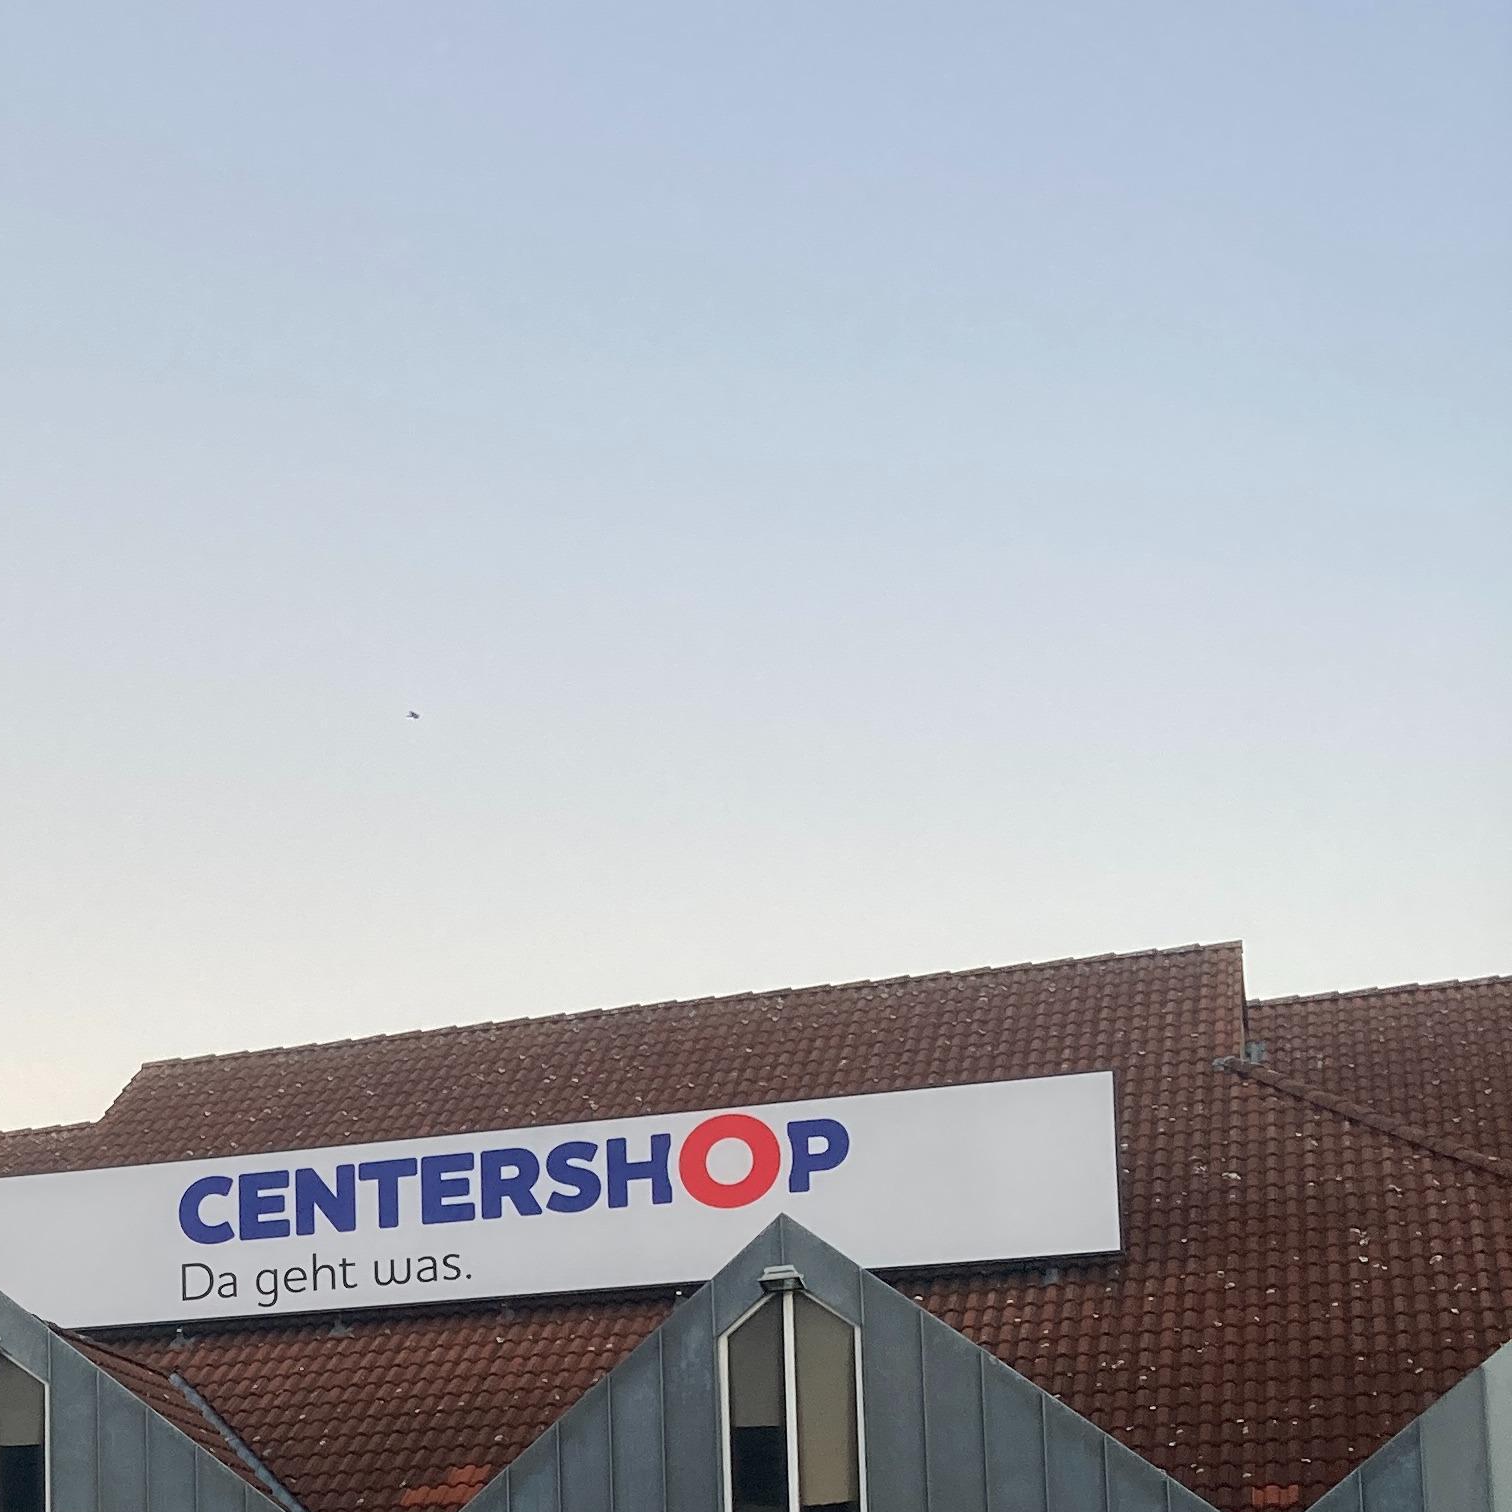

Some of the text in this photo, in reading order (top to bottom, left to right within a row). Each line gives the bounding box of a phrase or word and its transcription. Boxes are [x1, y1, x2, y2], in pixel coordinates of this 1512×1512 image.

[178, 1113, 850, 1246] CENTERSHOP
[181, 1252, 472, 1308] Da geht was.
